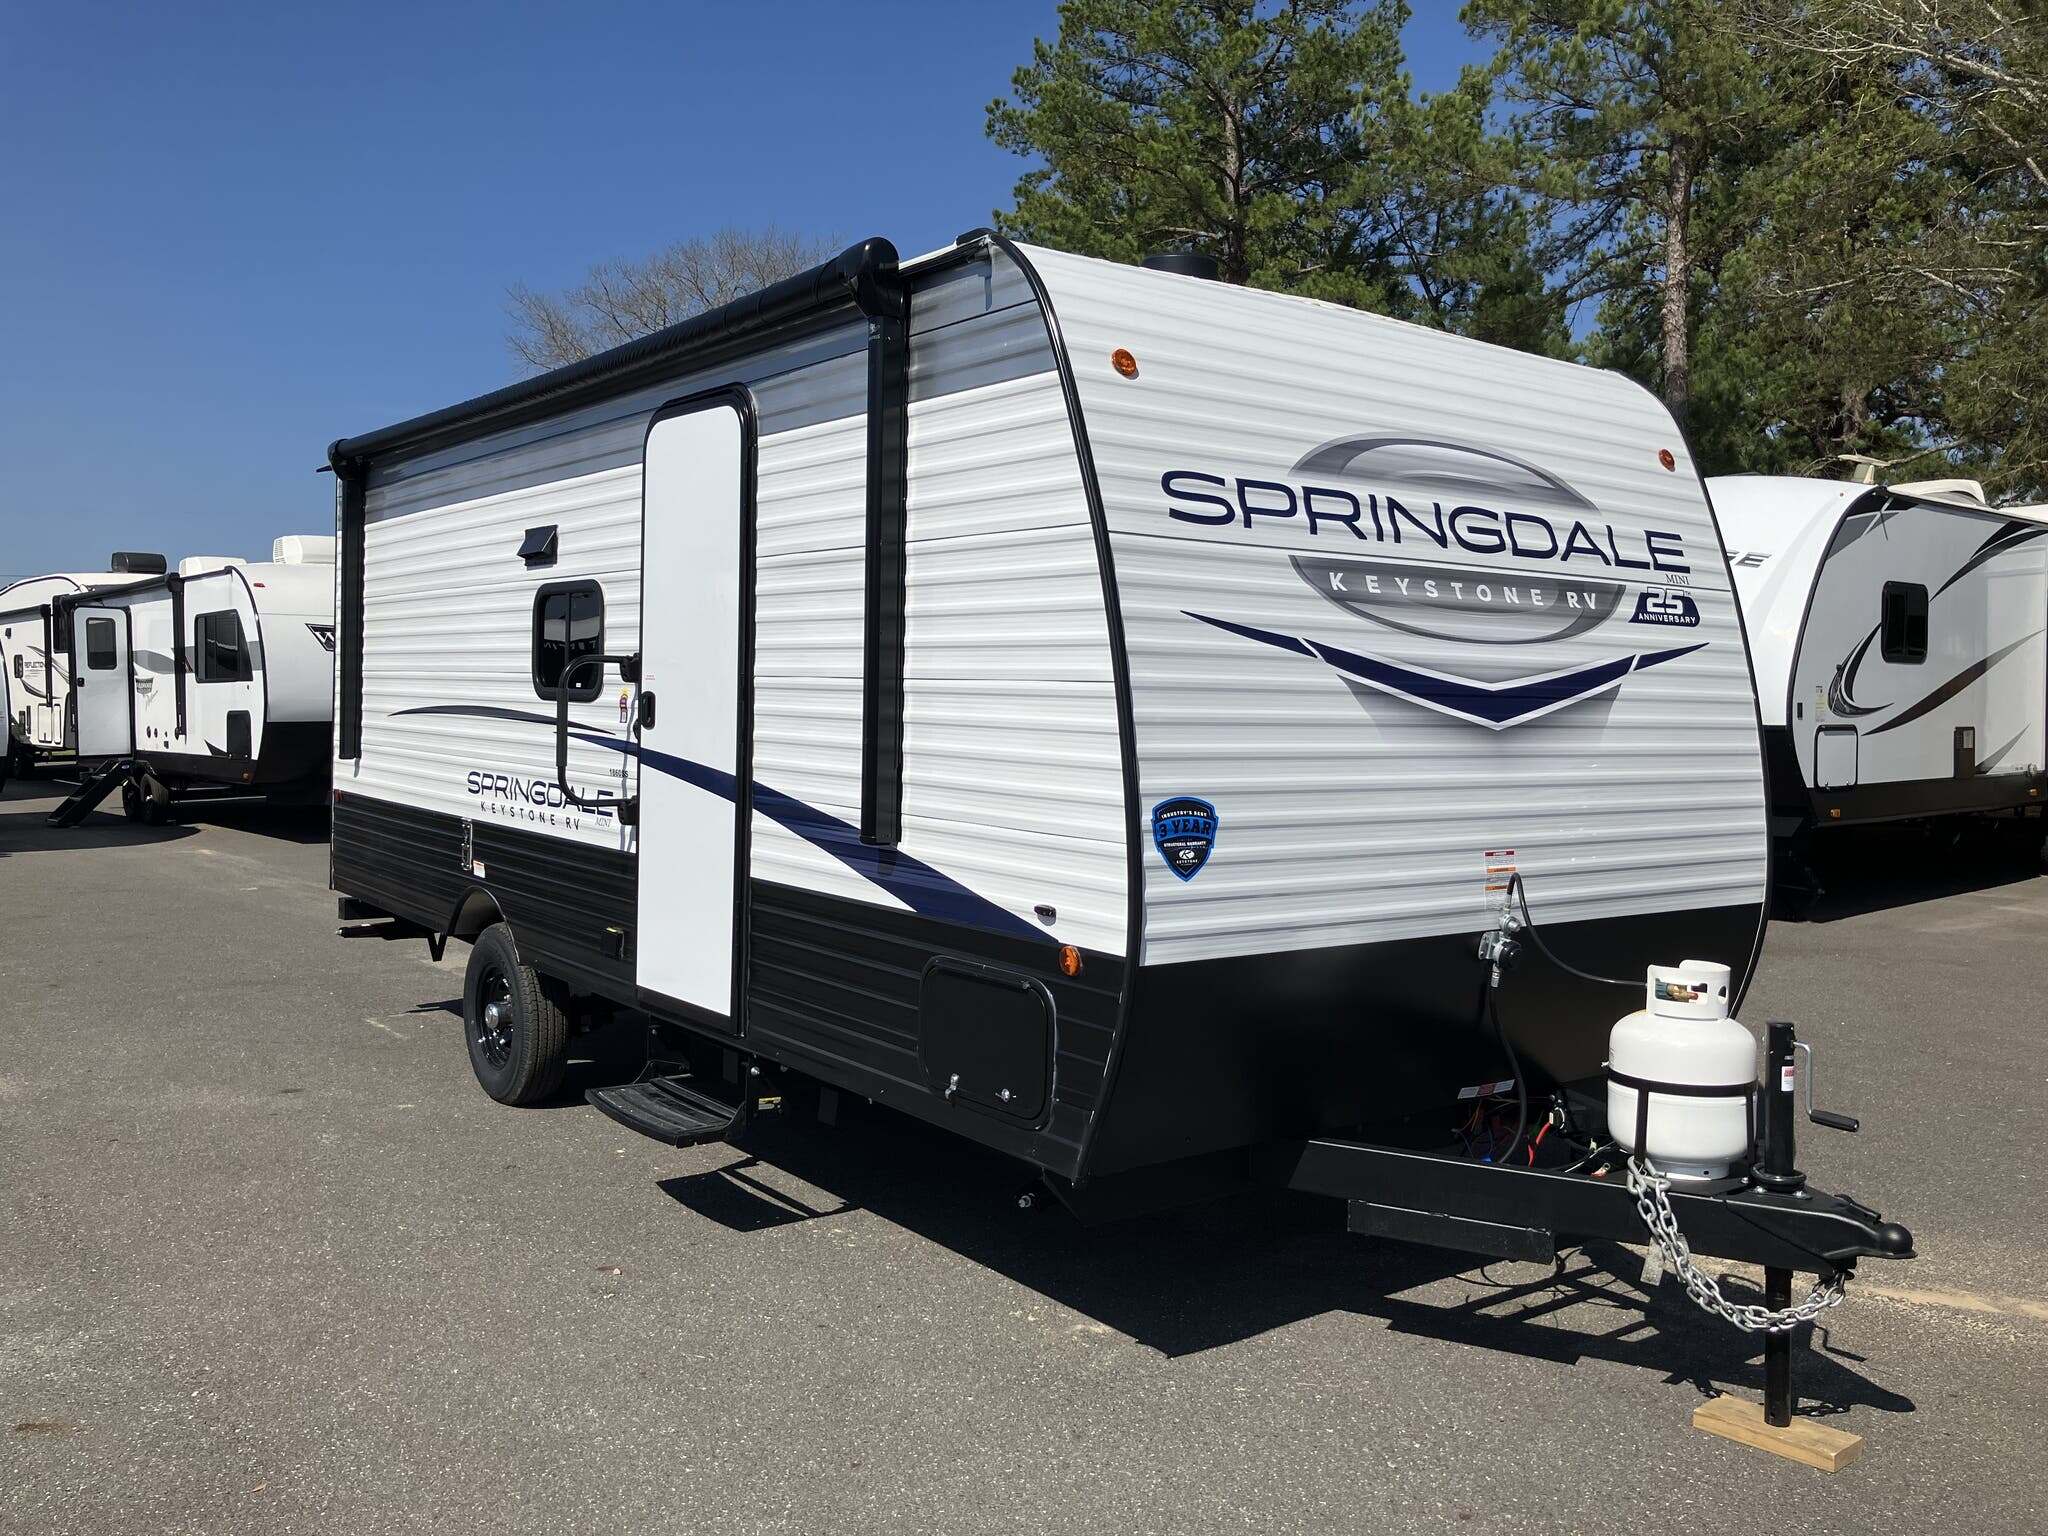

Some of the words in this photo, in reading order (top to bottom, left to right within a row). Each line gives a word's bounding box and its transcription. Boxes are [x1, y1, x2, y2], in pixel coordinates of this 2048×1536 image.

[1161, 470, 1691, 574] SPRINGDALE
[1329, 572, 1544, 606] KEYSTONE
[1566, 591, 1596, 610] RV
[1665, 573, 1690, 585] MINI
[1638, 612, 1696, 624] ANNIVERSARY
[467, 771, 614, 818] SPRINGDALE
[480, 801, 556, 826] KEYSTONE
[565, 816, 580, 830] RV
[1159, 823, 1168, 838] 3
[1171, 819, 1210, 835] YEAR
